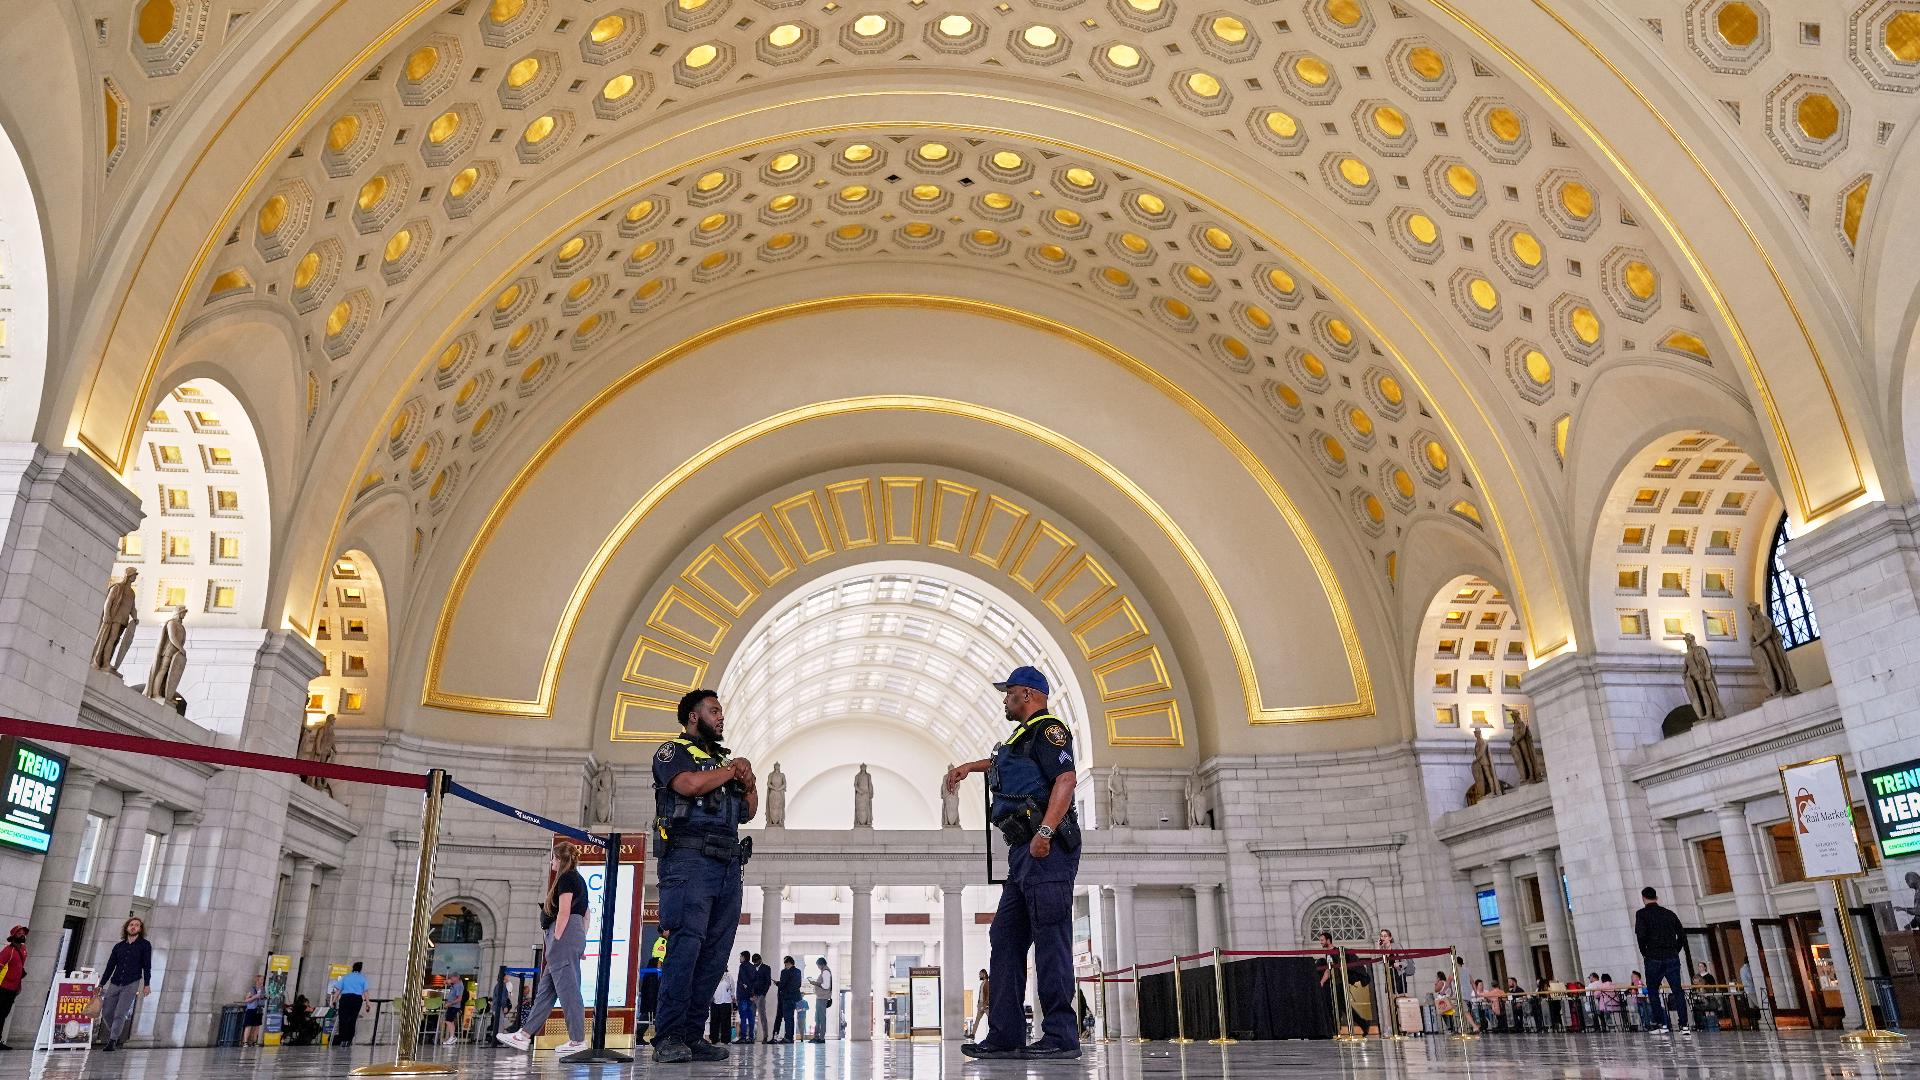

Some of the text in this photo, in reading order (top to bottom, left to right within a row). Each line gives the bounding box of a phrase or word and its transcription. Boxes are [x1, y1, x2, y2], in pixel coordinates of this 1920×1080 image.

[18, 749, 60, 782] TREND
[7, 773, 56, 815] HERE
[1878, 792, 1920, 824] HER
[1805, 809, 1848, 823] Rail Market
